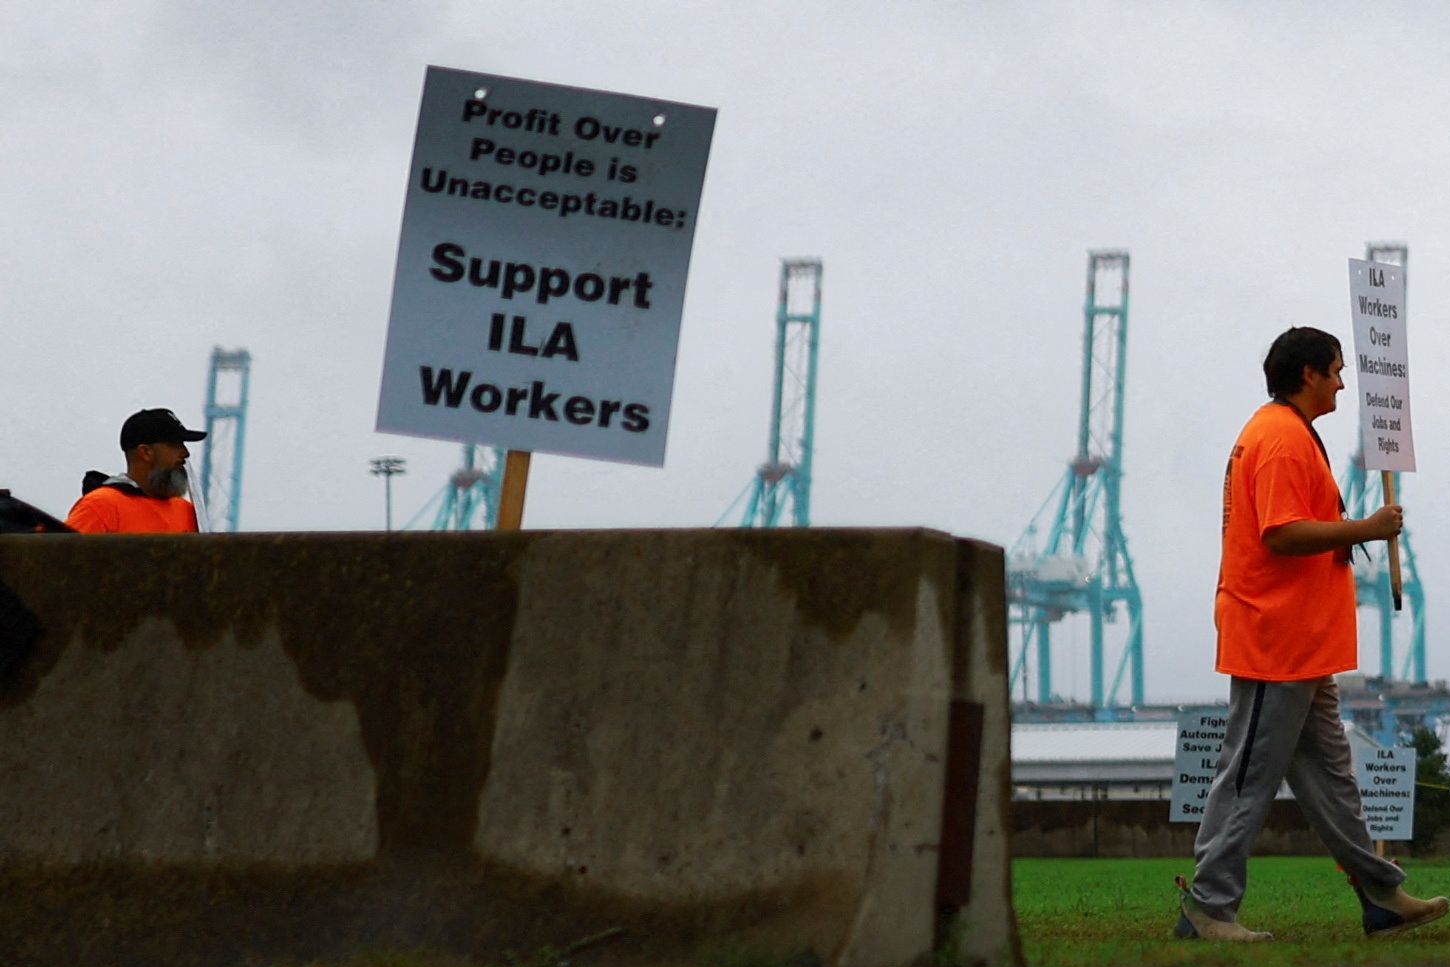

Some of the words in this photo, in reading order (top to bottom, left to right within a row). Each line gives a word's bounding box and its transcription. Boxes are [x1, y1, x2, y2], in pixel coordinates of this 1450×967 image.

[461, 99, 560, 136] Profit
[573, 116, 660, 150] Over
[469, 137, 595, 178] People
[607, 157, 639, 184] is
[428, 242, 654, 309] Support
[1369, 267, 1385, 288] ILA
[1358, 295, 1398, 319] Workers
[487, 312, 580, 362] ILA
[1370, 326, 1391, 347] Over
[1359, 354, 1406, 378] Machines:
[419, 365, 651, 434] Workers
[1366, 392, 1390, 409] Defend
[1391, 395, 1403, 411] Our
[1372, 414, 1388, 431] Jobs
[1389, 417, 1401, 431] and
[1378, 437, 1400, 455] Rights
[1200, 717, 1228, 728] Figh
[1180, 730, 1225, 739] Automa
[1183, 743, 1211, 752] Save
[1377, 750, 1394, 759] ILA
[1201, 758, 1218, 768] IL
[1365, 762, 1407, 772] Workers
[1373, 776, 1397, 785] Over
